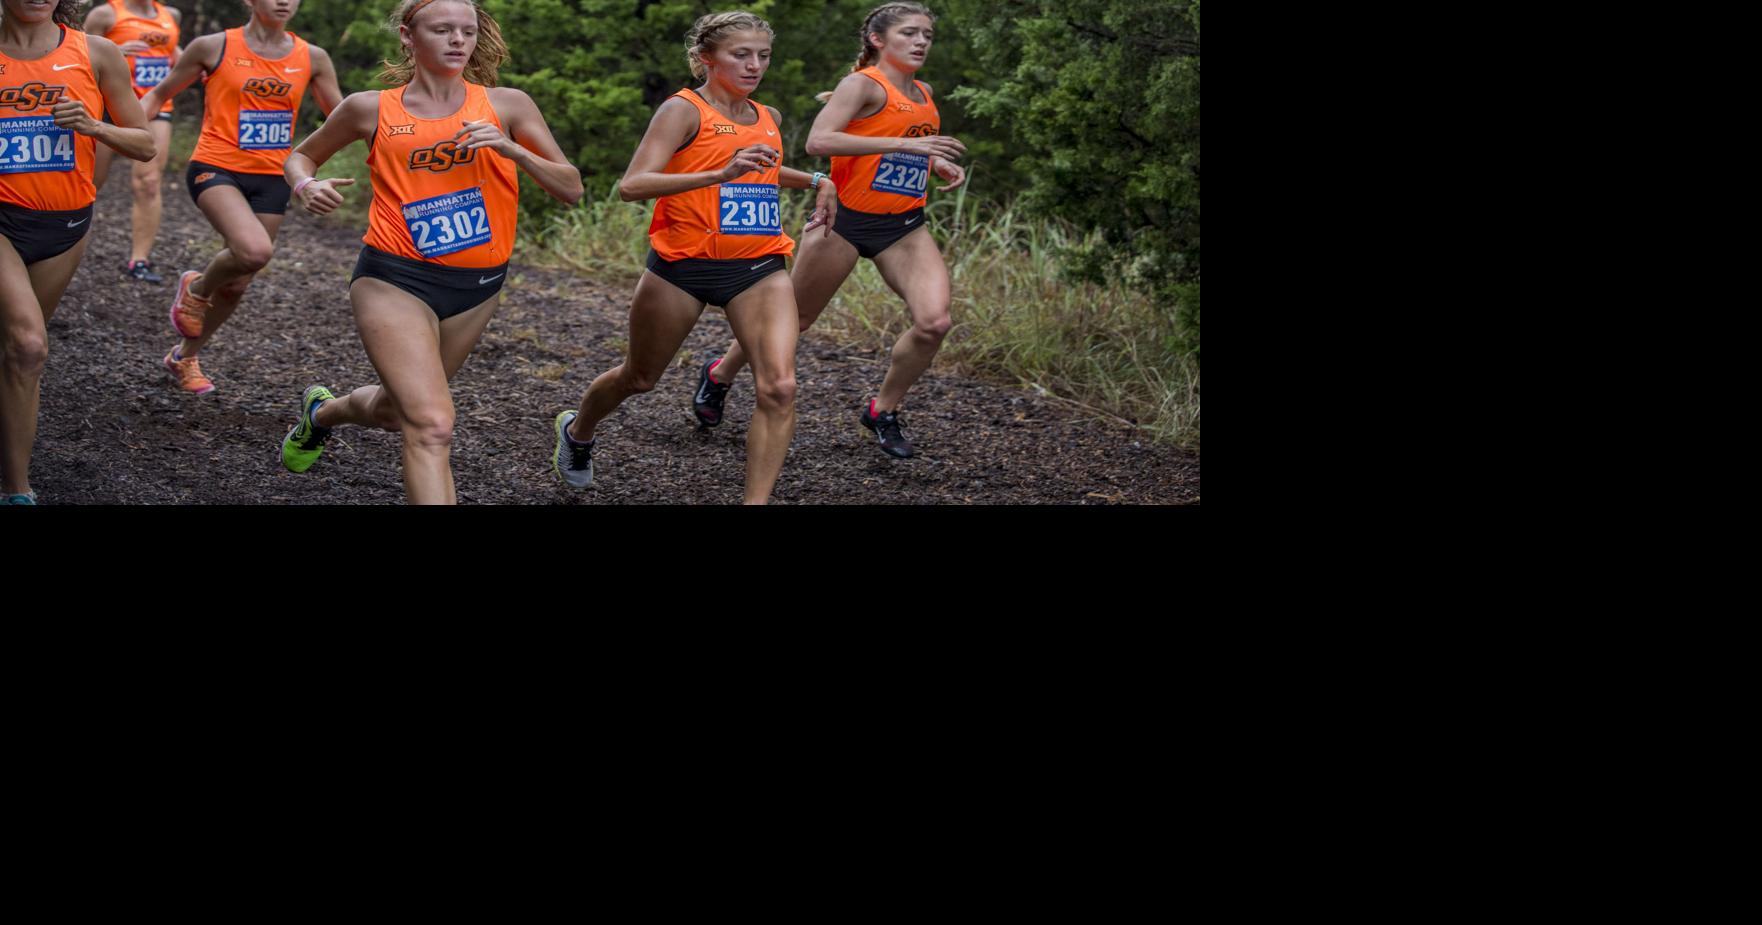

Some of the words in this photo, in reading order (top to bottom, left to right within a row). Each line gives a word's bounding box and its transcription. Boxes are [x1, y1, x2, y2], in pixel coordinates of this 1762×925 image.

[0, 82, 65, 111] OSU
[243, 77, 292, 97] OSU
[1, 119, 56, 129] MANHAT
[240, 123, 291, 144] 2305
[0, 134, 73, 163] 2304
[409, 140, 476, 173] OSU
[875, 162, 928, 191] 2320
[416, 190, 482, 212] MANHATTAN
[417, 204, 453, 217] RUNNING
[721, 201, 779, 227] 2303
[411, 206, 489, 250] 2302
